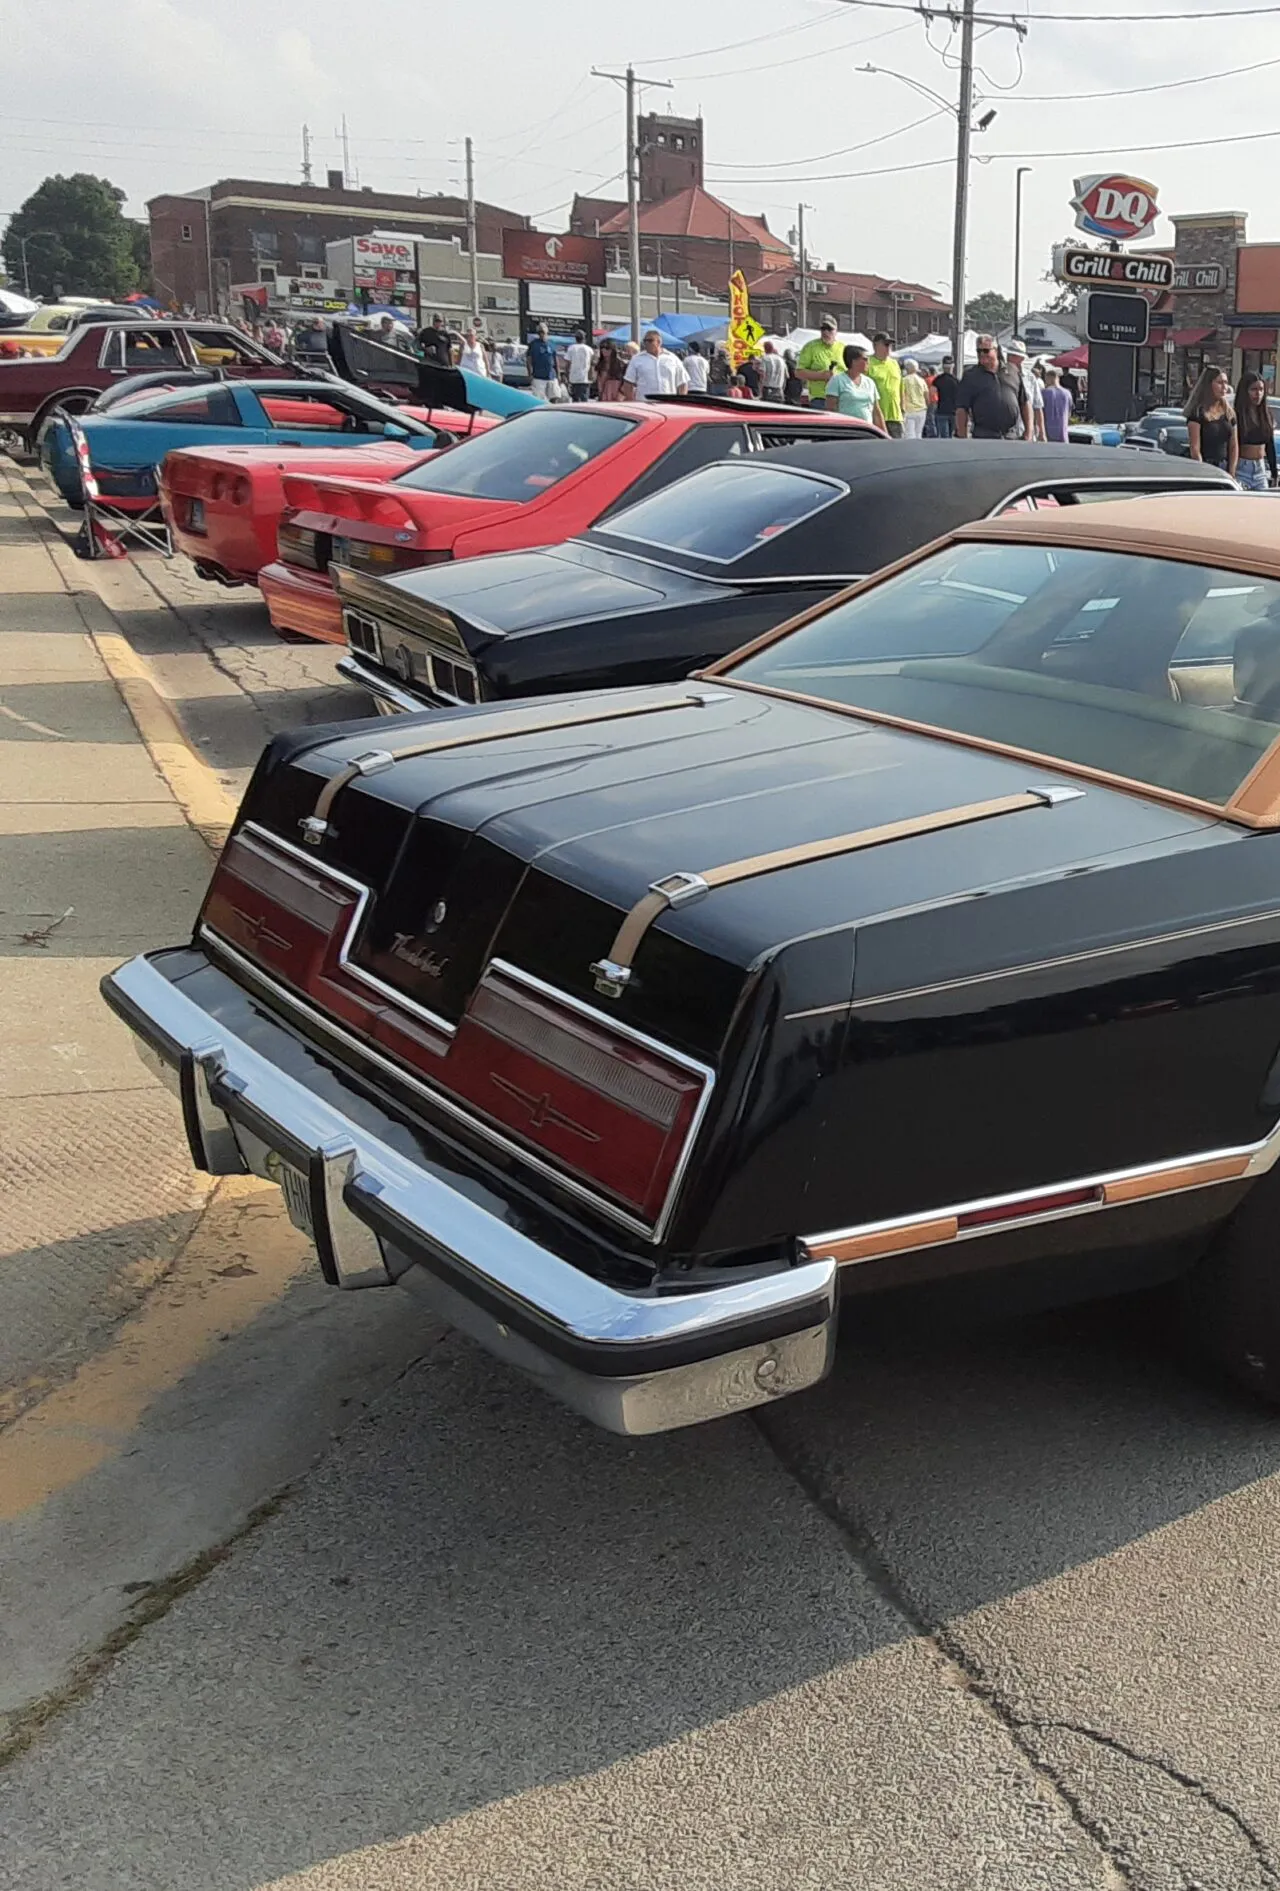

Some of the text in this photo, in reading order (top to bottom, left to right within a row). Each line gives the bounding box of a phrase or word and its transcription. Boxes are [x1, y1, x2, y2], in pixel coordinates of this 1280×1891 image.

[1094, 188, 1149, 227] DQ
[357, 239, 408, 256] Save
[1070, 255, 1168, 283] Grill & Chill
[1196, 270, 1218, 286] Chill
